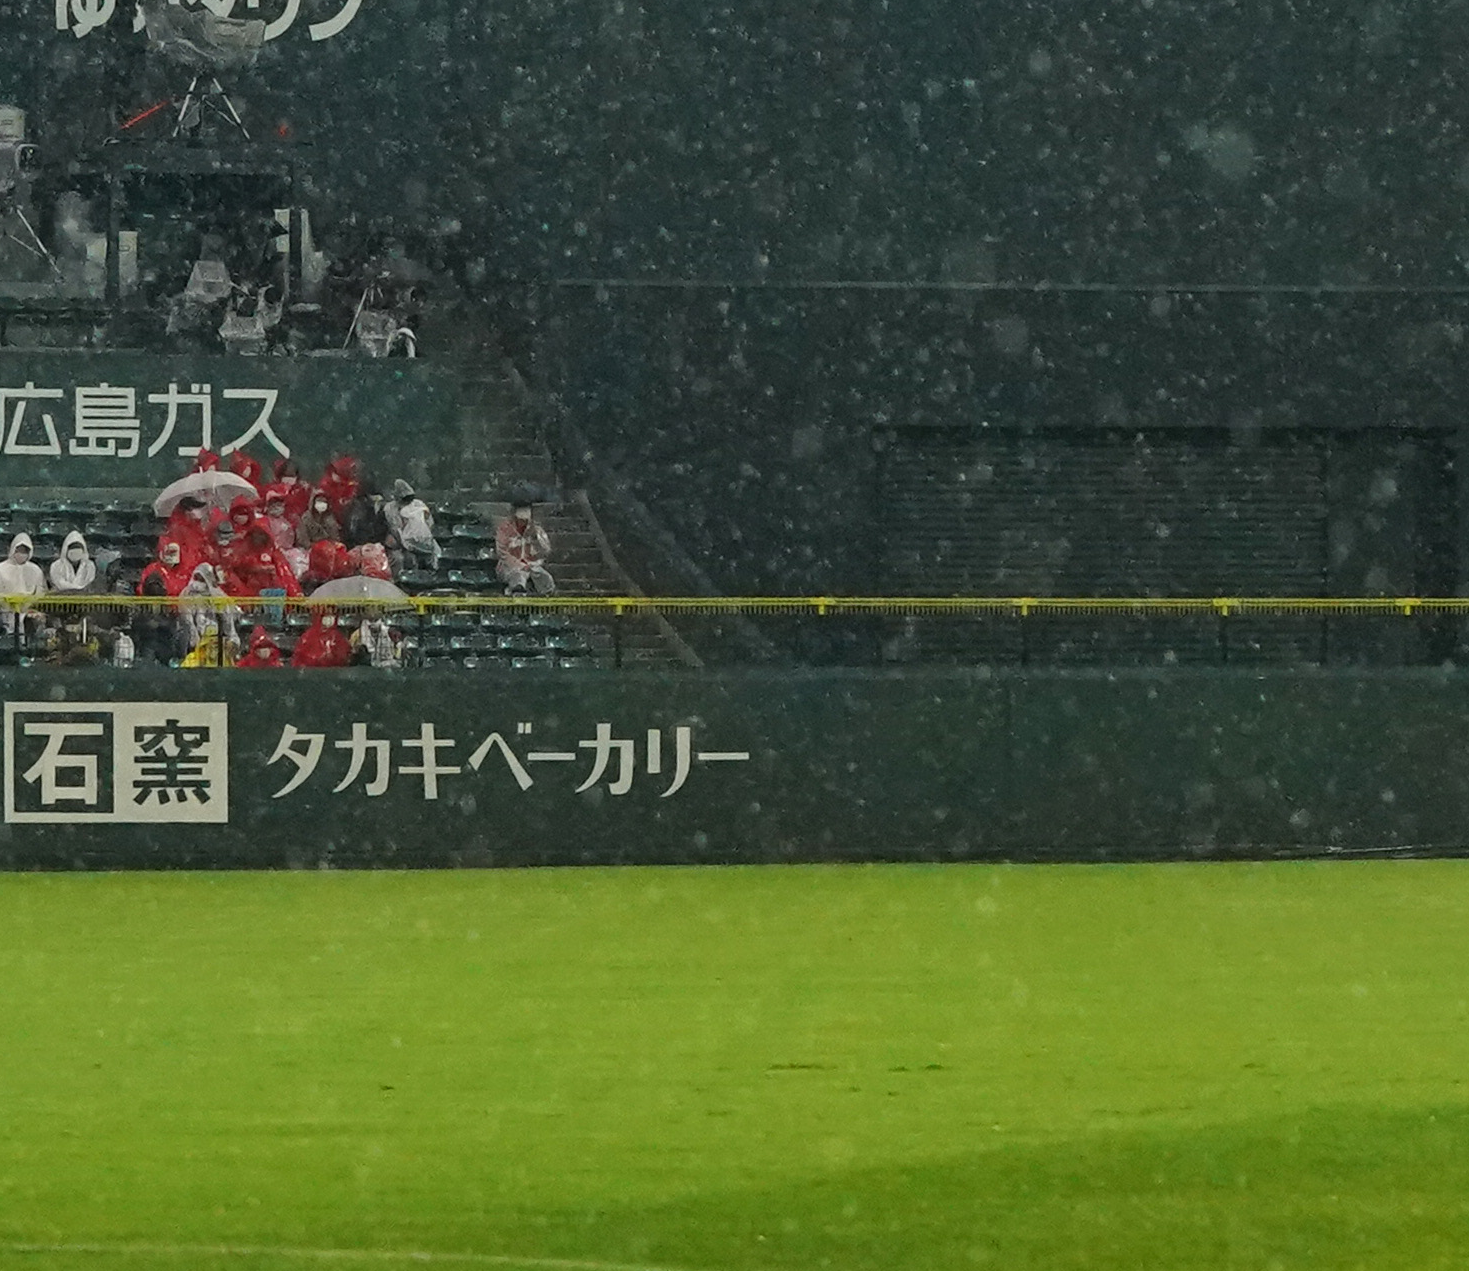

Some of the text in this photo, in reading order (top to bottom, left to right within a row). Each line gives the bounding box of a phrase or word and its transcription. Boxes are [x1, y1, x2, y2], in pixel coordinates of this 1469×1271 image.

[21, 717, 213, 806] 石窯
[266, 721, 750, 800] タカキベーカリー
